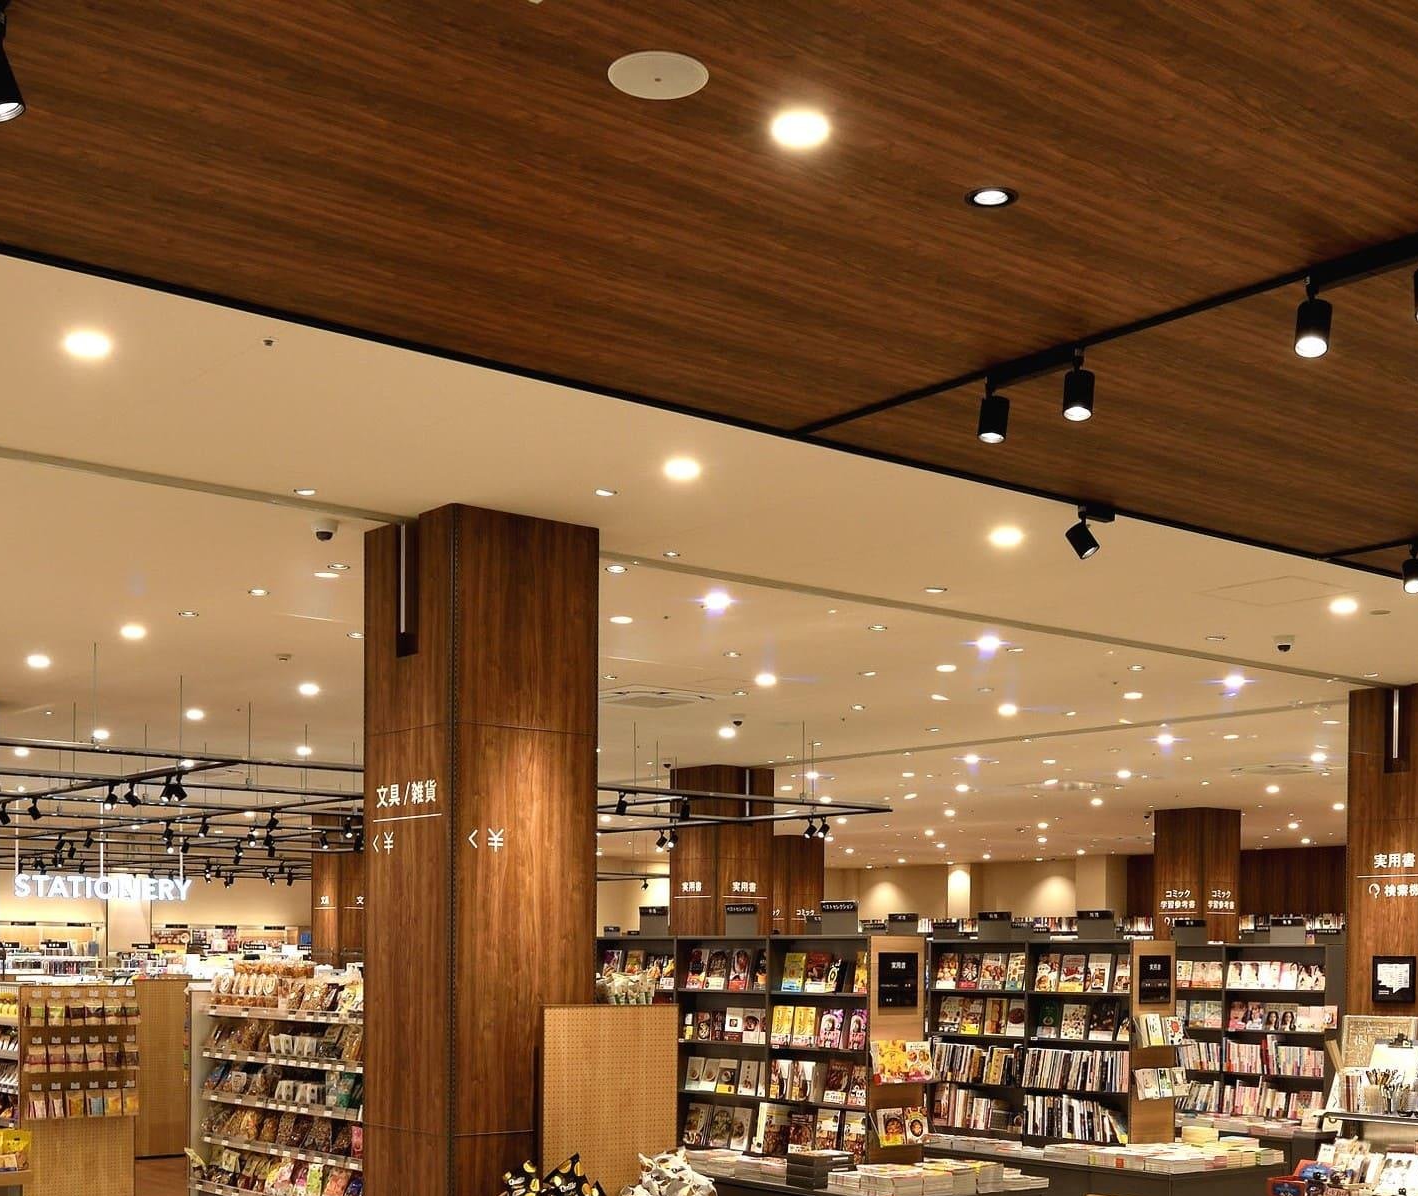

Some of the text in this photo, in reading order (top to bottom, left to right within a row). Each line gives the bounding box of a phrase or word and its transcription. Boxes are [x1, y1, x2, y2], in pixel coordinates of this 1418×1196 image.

[1373, 852, 1416, 868] 実用書
[14, 873, 192, 901] STATIONERY
[681, 881, 702, 892] 実用書
[732, 881, 757, 893] 実用書
[1165, 889, 1191, 898] コミック
[1211, 889, 1231, 899] コミック
